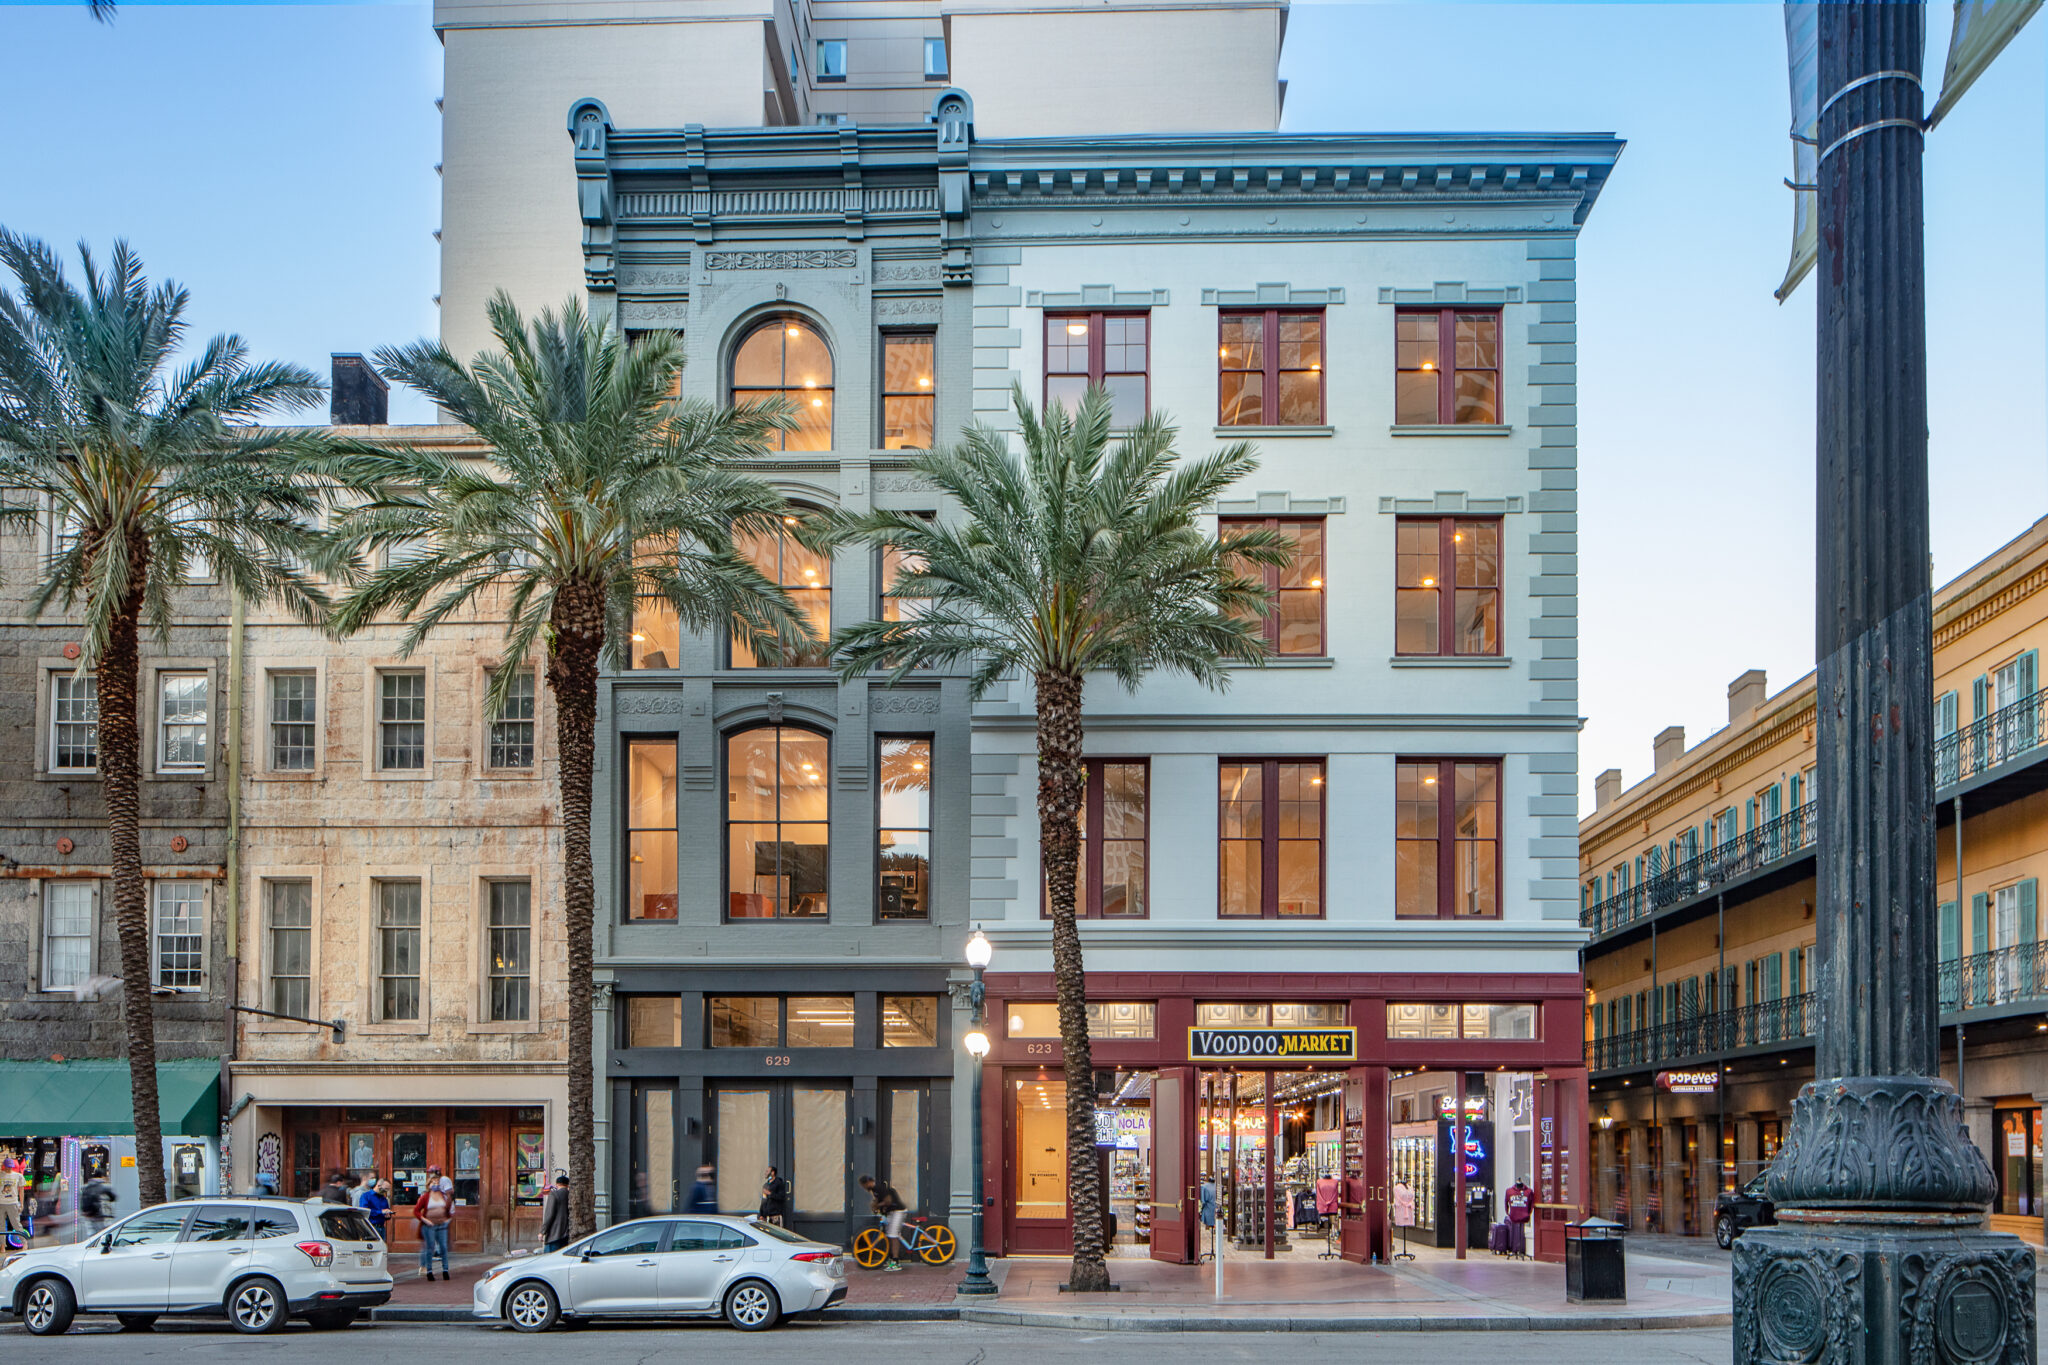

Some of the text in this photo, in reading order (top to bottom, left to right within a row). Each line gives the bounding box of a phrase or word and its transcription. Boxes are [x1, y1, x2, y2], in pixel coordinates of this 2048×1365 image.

[1027, 1043, 1052, 1054] 623
[1199, 1032, 1349, 1055] VOODOO MARKET
[765, 1055, 790, 1066] 629
[1118, 1117, 1145, 1129] NOLA
[262, 1141, 276, 1158] ALL
[263, 1157, 276, 1170] WE
